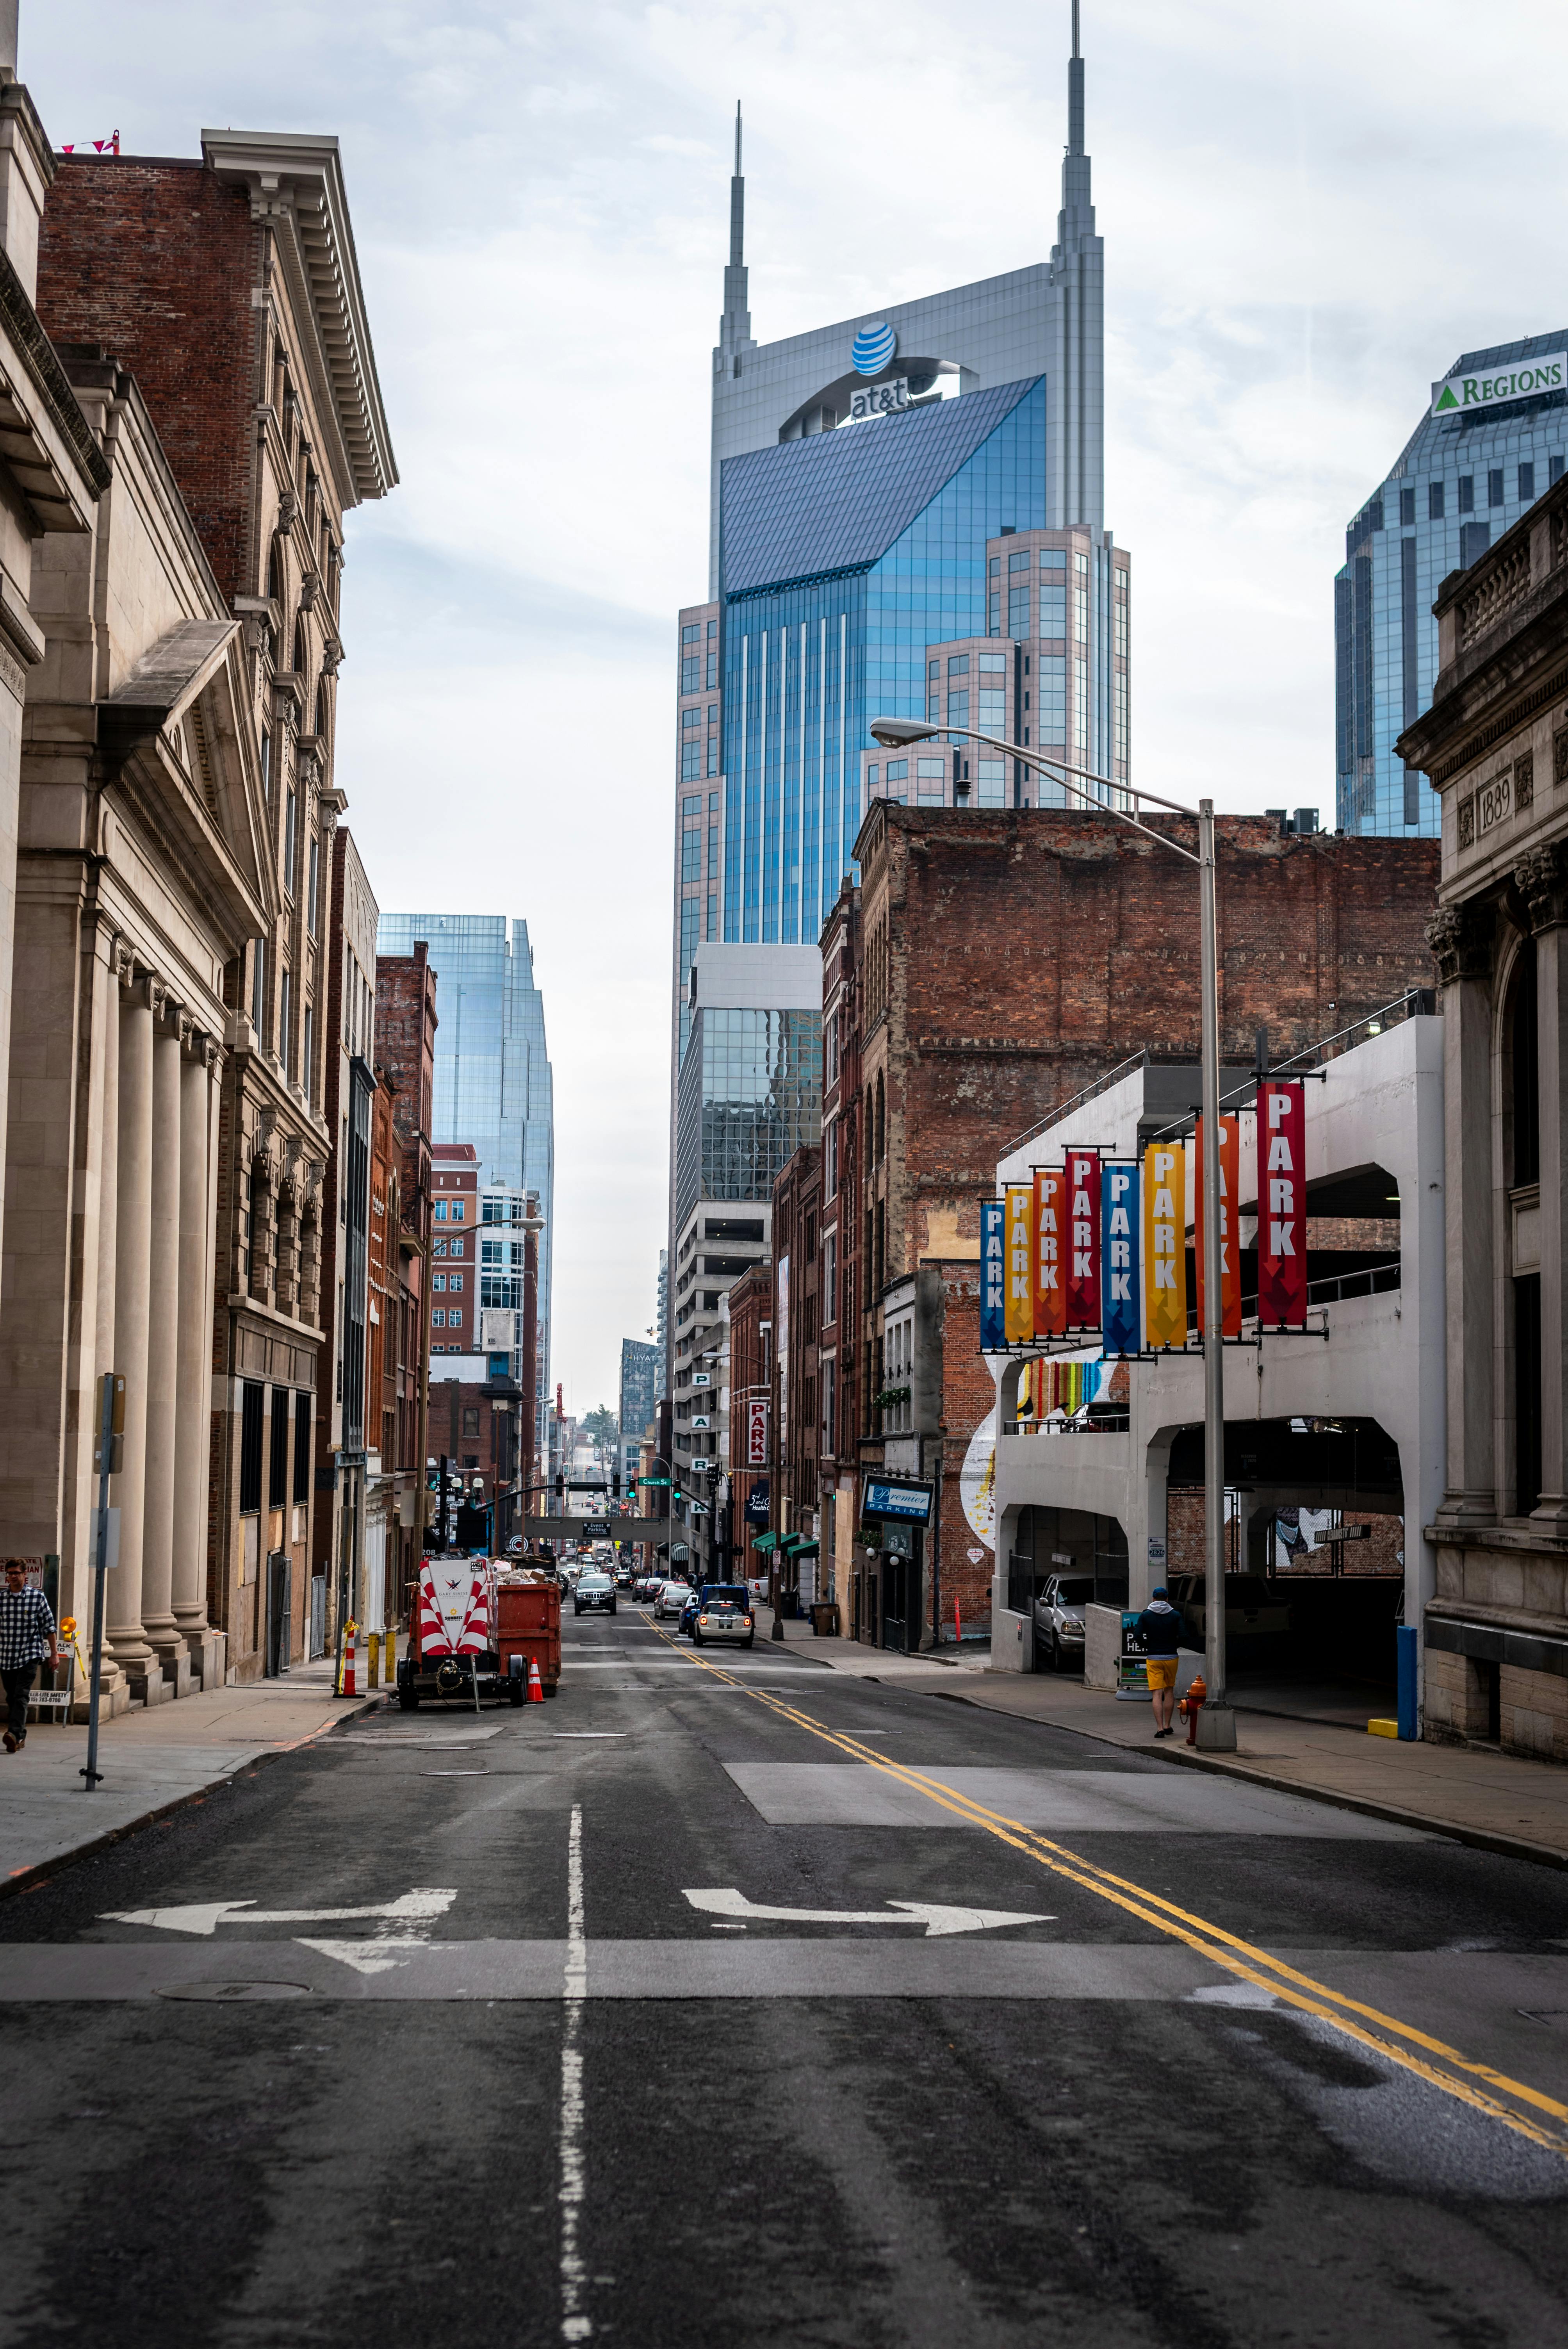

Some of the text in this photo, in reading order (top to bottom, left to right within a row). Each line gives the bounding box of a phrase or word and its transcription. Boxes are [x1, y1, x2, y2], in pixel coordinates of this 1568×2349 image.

[852, 380, 905, 419] at&t
[1462, 363, 1561, 405] REGIONS
[1483, 778, 1510, 830] 1889
[1268, 1094, 1296, 1256] PARK
[1012, 1196, 1029, 1298] PARK
[1039, 1180, 1058, 1289] PARK
[1073, 1160, 1092, 1277] PARK
[1109, 1174, 1131, 1300] PARK
[1153, 1153, 1177, 1288] PARK
[986, 1211, 1003, 1308] PARK
[751, 1405, 764, 1452] PARK
[749, 1492, 761, 1506] 3rd
[870, 1503, 924, 1515] PARKING
[873, 1487, 927, 1503] Premier
